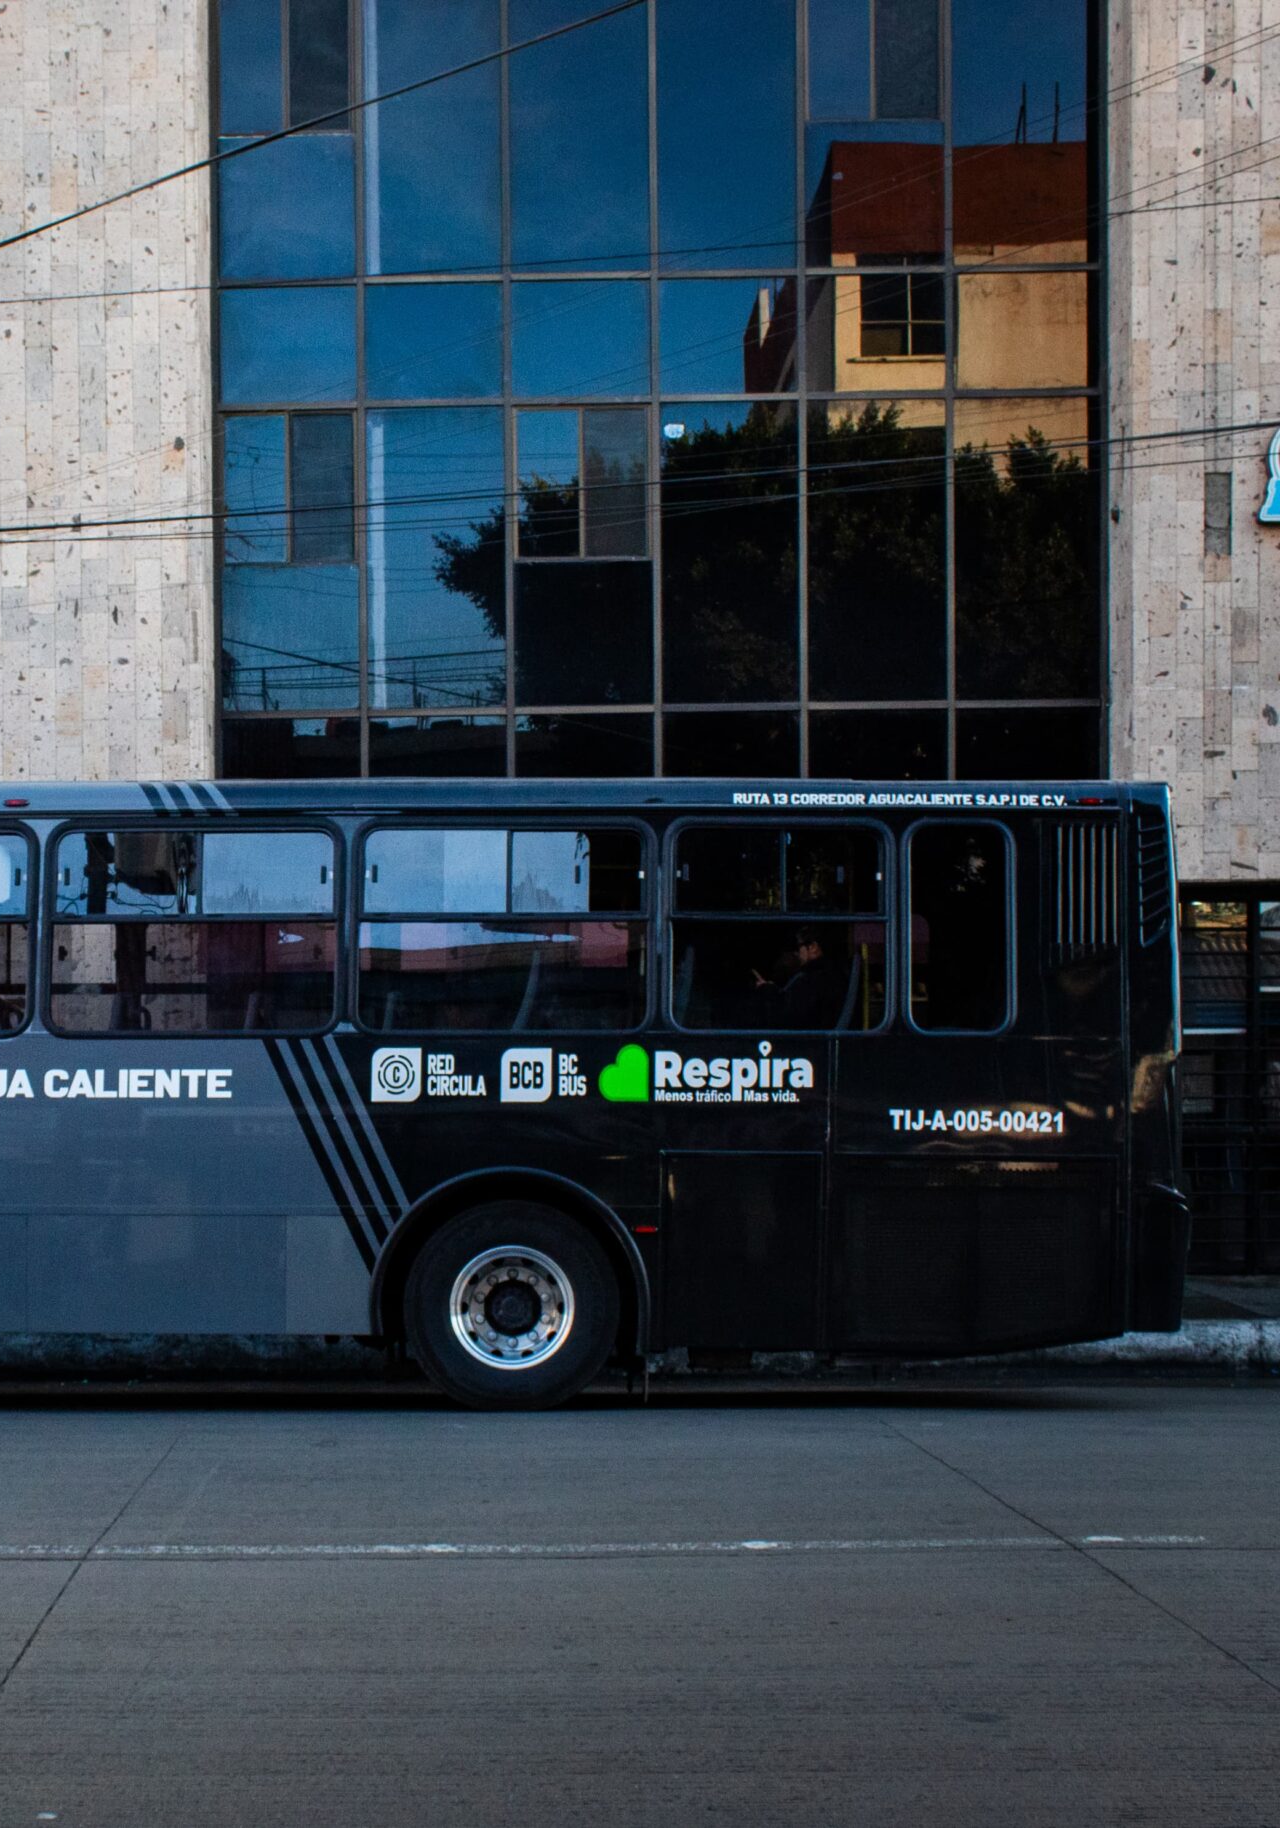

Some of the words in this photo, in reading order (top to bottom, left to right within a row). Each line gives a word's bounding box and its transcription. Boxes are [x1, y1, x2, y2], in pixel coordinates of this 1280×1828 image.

[733, 793, 770, 805] RUTA
[773, 793, 788, 805] 13
[791, 793, 865, 805] CORREDOR
[868, 794, 973, 806] AGUACALIENTE
[1019, 795, 1039, 806] DE
[1041, 795, 1068, 807] C.V.
[427, 1054, 455, 1075] RED
[509, 1061, 544, 1089] BCB
[558, 1054, 578, 1075] BC
[654, 1040, 814, 1101] Respira
[44, 1069, 232, 1098] CALIENTE
[427, 1075, 486, 1096] CIRCULA
[558, 1075, 587, 1096] BUS
[654, 1090, 693, 1102] Menos
[695, 1090, 731, 1103] tráfico
[744, 1090, 769, 1102] Mas
[772, 1090, 800, 1103] vida.
[889, 1109, 1064, 1133] TIJ-A-005-00421
